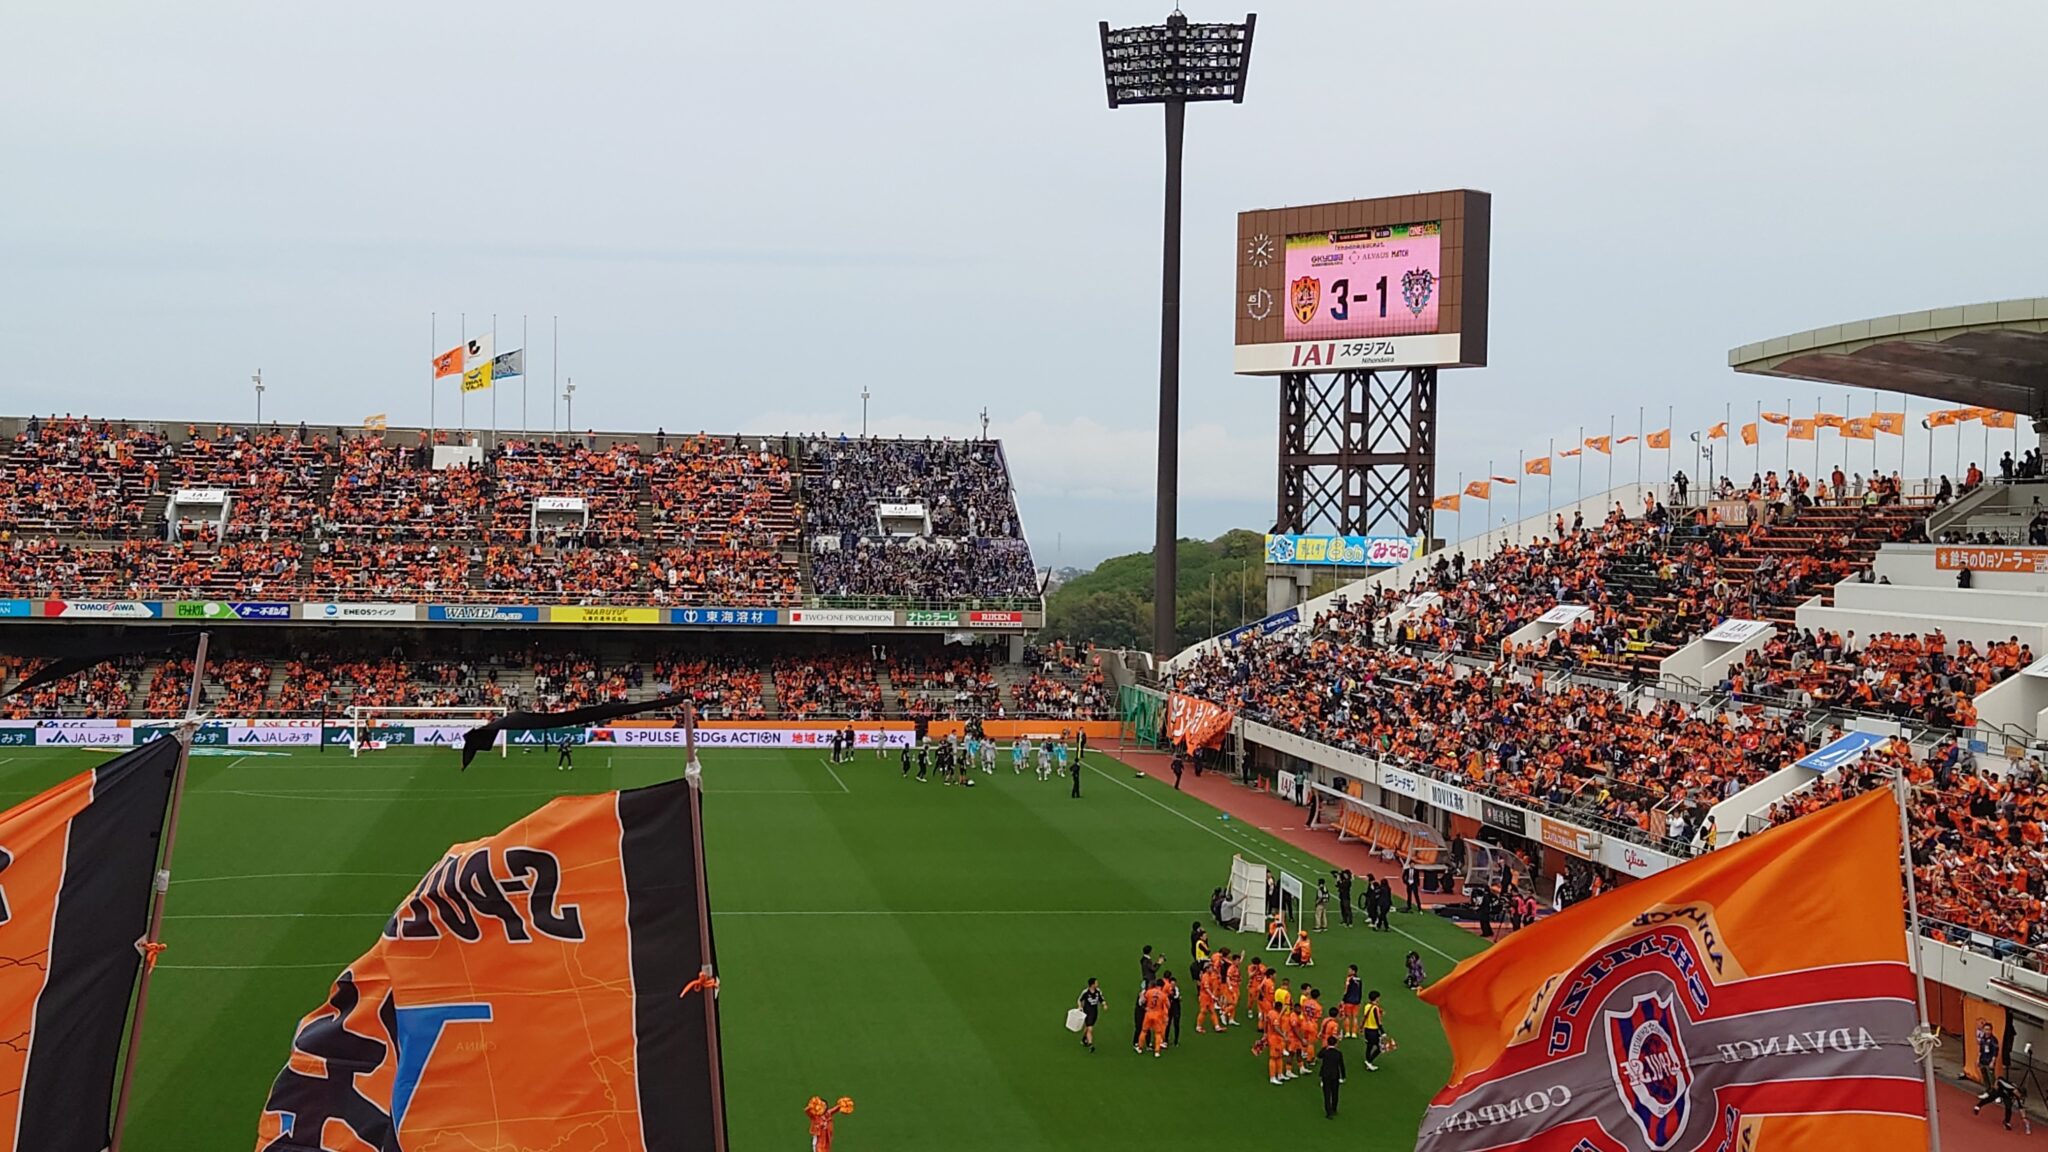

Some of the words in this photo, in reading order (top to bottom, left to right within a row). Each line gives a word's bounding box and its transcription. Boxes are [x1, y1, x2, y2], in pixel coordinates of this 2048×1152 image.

[1292, 343, 1335, 367] IAI
[1341, 341, 1394, 357] スタジアム
[1373, 543, 1409, 559] みてね
[343, 608, 396, 616] ENEOSウイング
[445, 606, 497, 619] WAMEI
[706, 610, 764, 623] 東海溶材
[908, 612, 957, 621] ナトゥラーレ
[804, 614, 844, 622] TWO-ONE
[845, 614, 892, 623] PROMOTION
[71, 733, 124, 743] JAしみず
[262, 733, 313, 743] JAしみず
[625, 731, 680, 743] S-PULSE
[693, 731, 727, 743] SDGs
[1624, 848, 1648, 870] Glico
